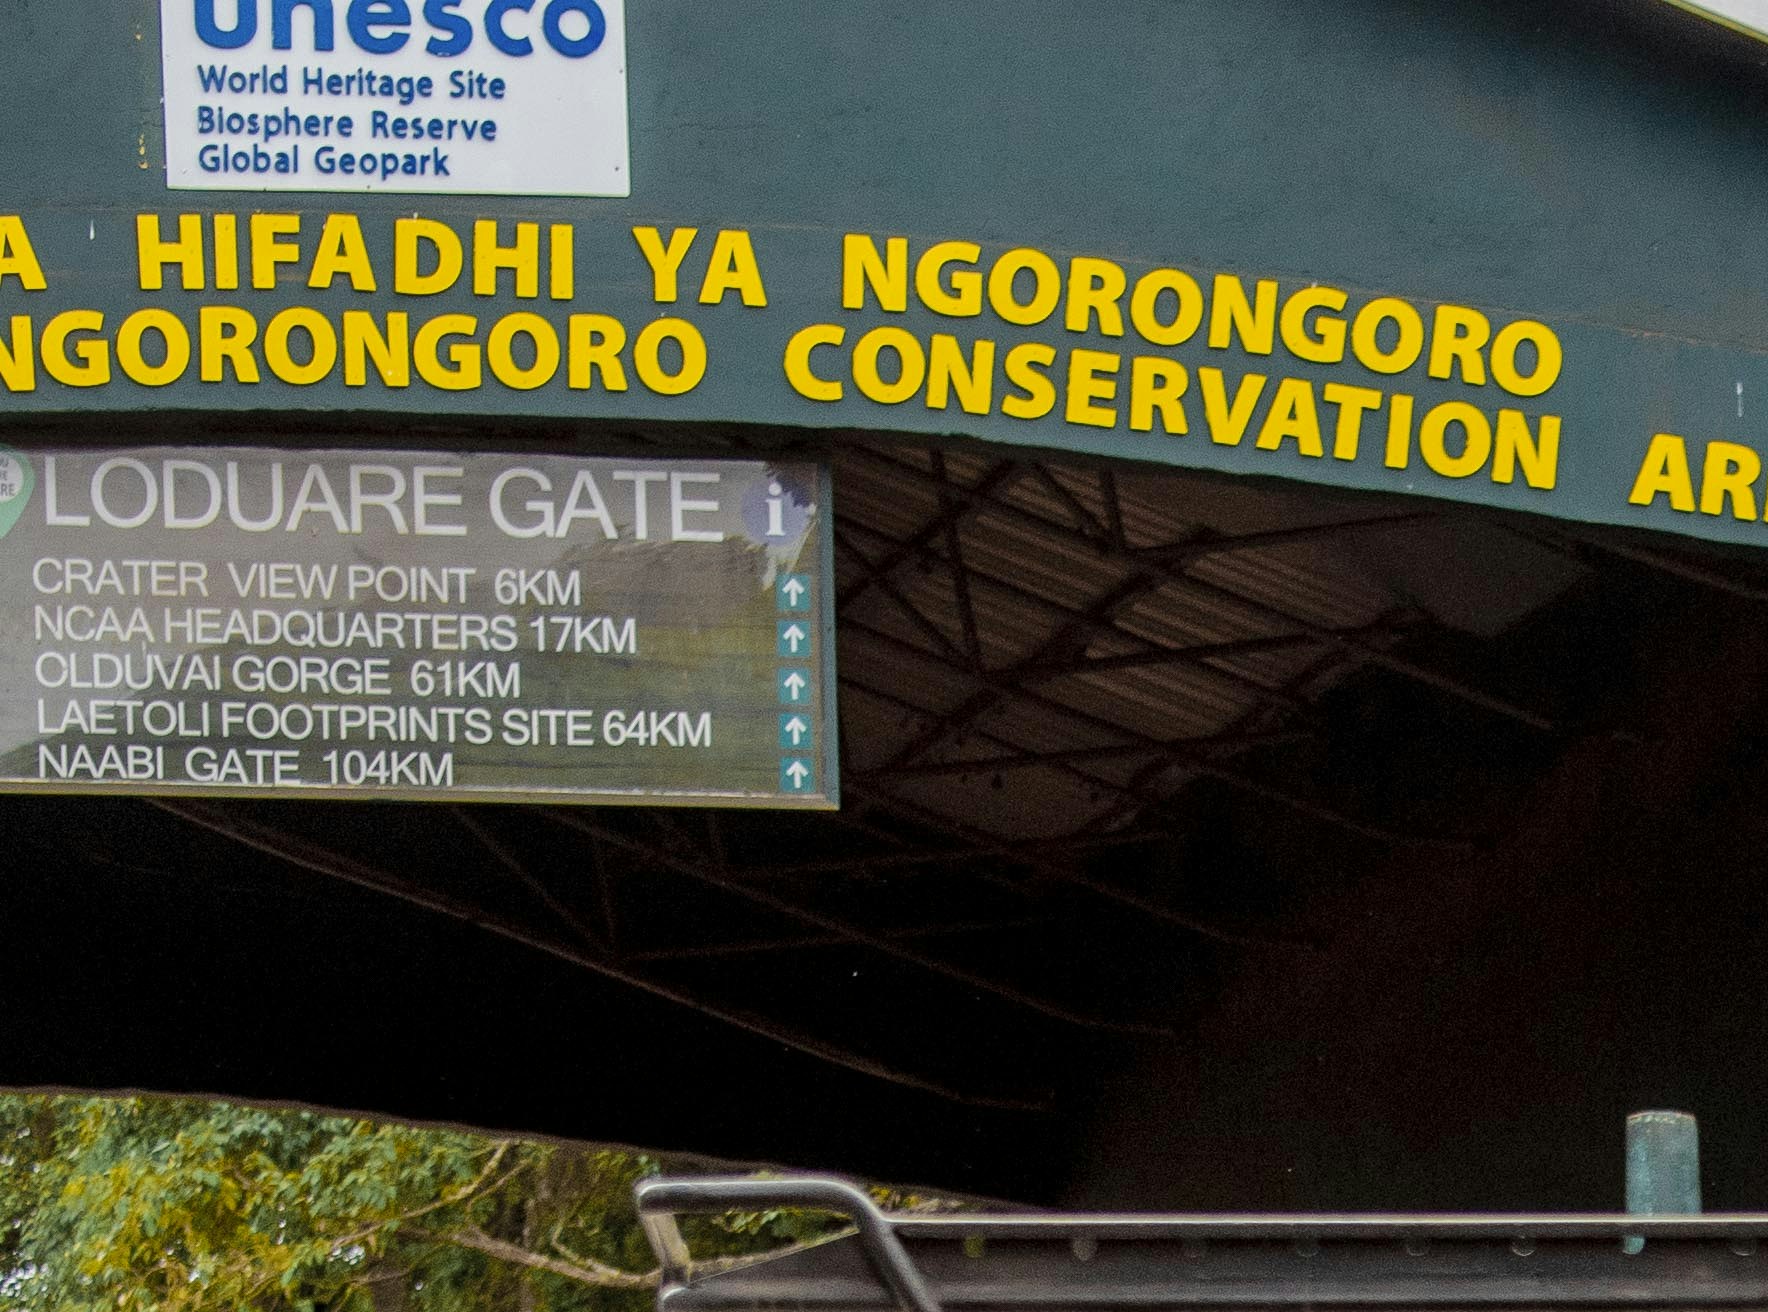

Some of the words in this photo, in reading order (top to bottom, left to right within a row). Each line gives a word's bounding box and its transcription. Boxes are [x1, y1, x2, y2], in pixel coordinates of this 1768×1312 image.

[194, 0, 605, 58] unesco
[196, 64, 288, 95] World
[302, 66, 433, 105] Heritage
[449, 69, 506, 99] Site
[197, 106, 353, 141] Biosphere
[371, 111, 497, 141] Reserve
[198, 145, 299, 173] Global
[313, 147, 450, 180] Geopark
[136, 213, 574, 299] HIFADHI
[633, 226, 767, 307] YA
[842, 233, 1563, 397] NGORONGORO
[0, 305, 708, 395] NGORONGORO
[783, 323, 1562, 491] CONSERVATION
[45, 456, 467, 535] LODUARE
[489, 467, 724, 543] GATE
[32, 557, 209, 597] CRATER
[227, 562, 338, 600] VIEW
[348, 564, 476, 603] POINT
[494, 569, 582, 607] 6KM
[35, 605, 154, 643] NCAA
[165, 608, 518, 651] HEADQUARTERS
[529, 616, 637, 654] 17KM
[35, 651, 221, 691] OLDUVAI
[232, 655, 392, 695] GORGE
[410, 660, 521, 699] 61KM
[37, 698, 209, 737] LAETOLI
[221, 702, 493, 744] FOOTPRINTS
[502, 708, 594, 746] SITE
[602, 710, 712, 748] 64KM
[39, 744, 164, 779] NAABI
[185, 746, 299, 785] GATE
[323, 750, 454, 787] 104KM
